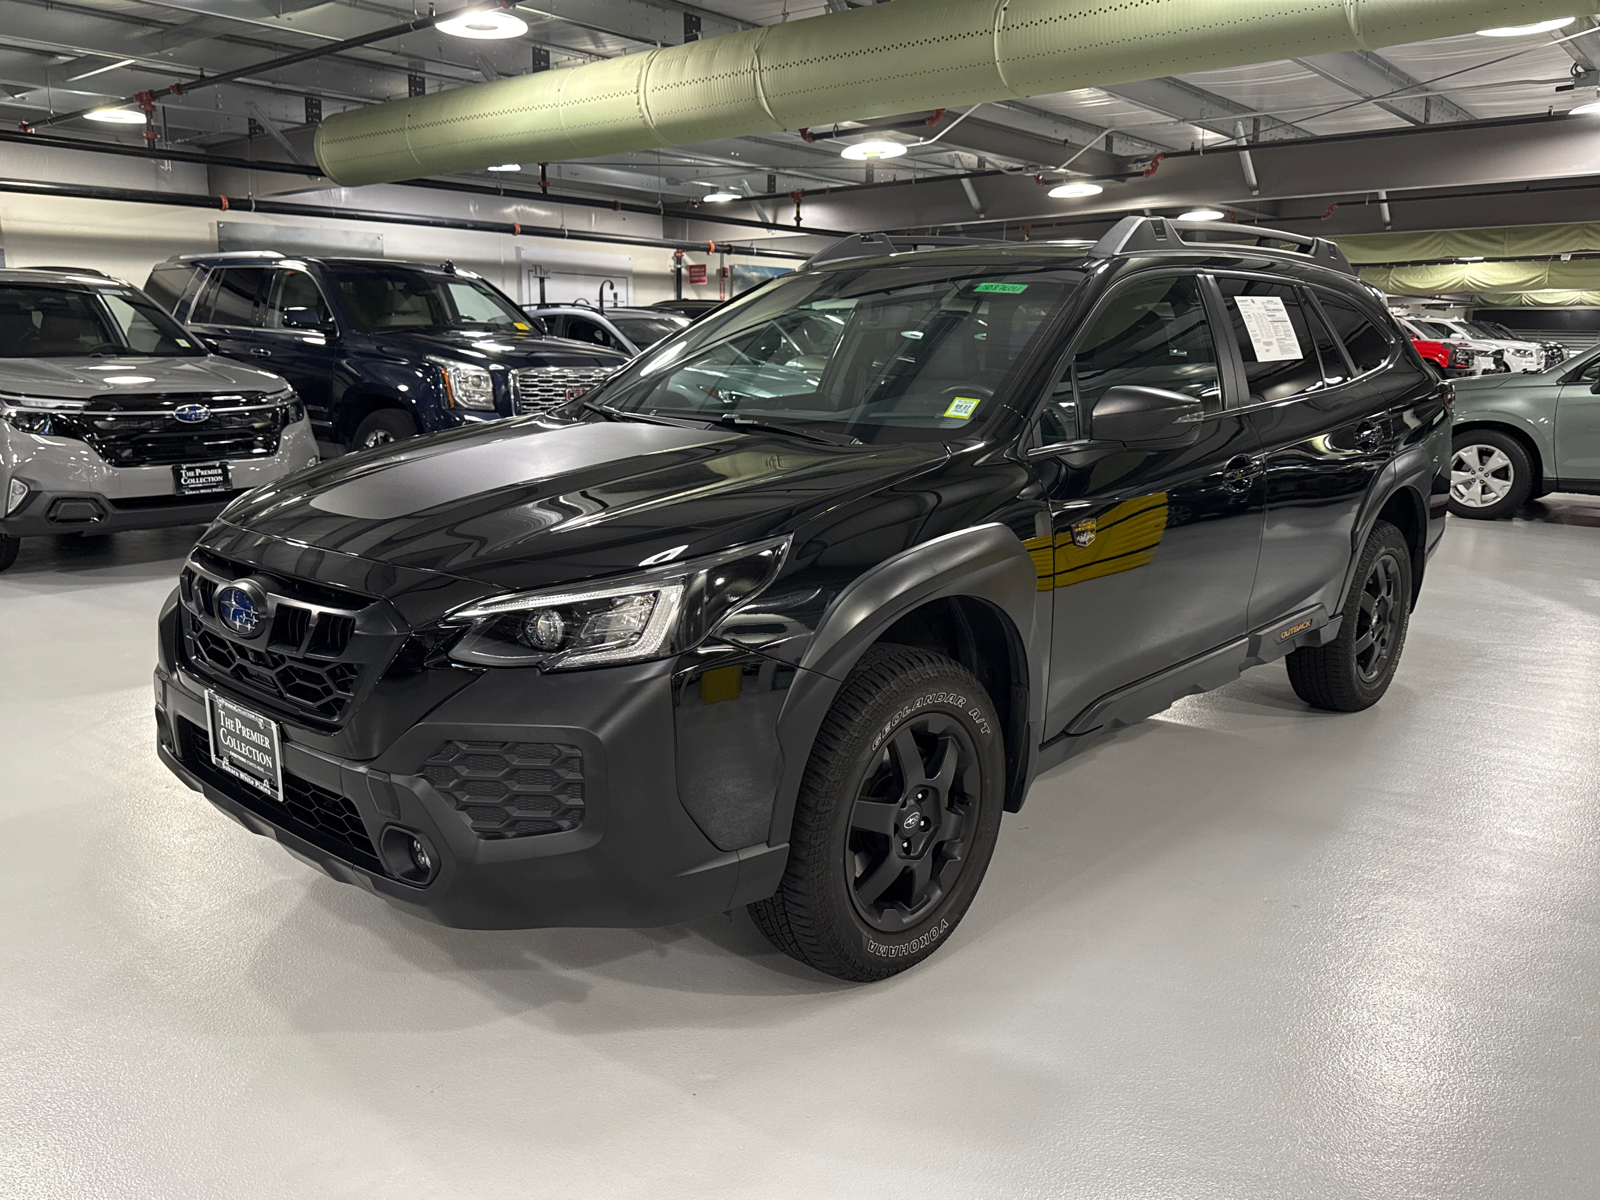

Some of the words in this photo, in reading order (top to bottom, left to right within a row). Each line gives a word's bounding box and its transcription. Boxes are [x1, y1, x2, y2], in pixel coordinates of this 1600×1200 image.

[180, 469, 195, 478] THE
[195, 468, 222, 476] PREMIER
[181, 475, 223, 485] COLLECTION
[1280, 619, 1311, 639] OUTBACK
[218, 709, 235, 732] THE
[235, 717, 271, 749] PREMIER
[872, 692, 967, 751] GEOLANDAR
[968, 708, 991, 734] A/T
[219, 728, 273, 769] COLLECTION
[867, 918, 949, 957] YOKOHAMA
